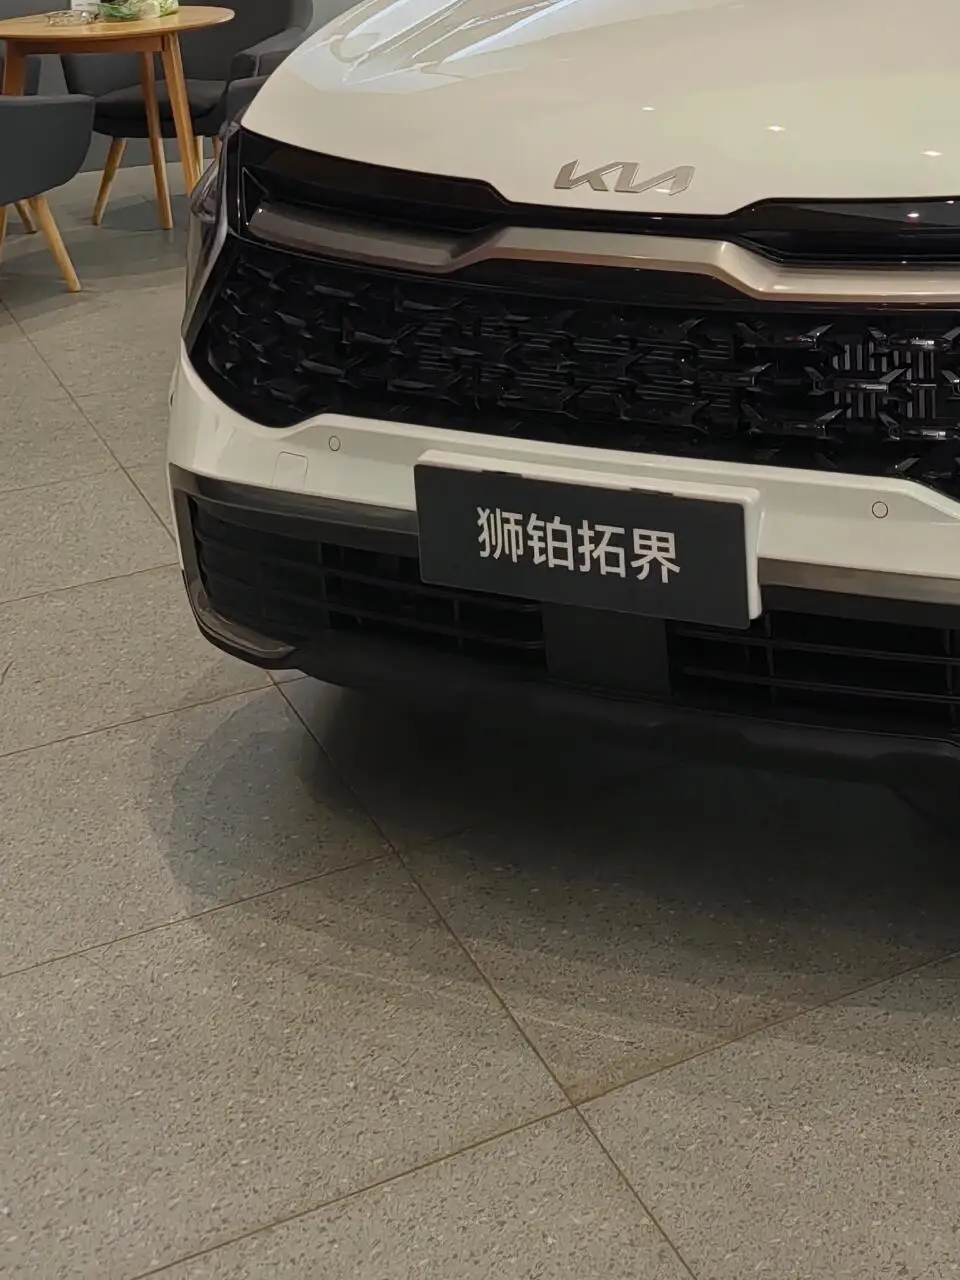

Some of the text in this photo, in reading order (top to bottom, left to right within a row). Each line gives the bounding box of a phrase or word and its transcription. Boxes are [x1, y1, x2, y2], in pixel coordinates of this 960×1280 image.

[553, 158, 696, 197] KIA
[476, 507, 681, 584] 狮铂拓界
